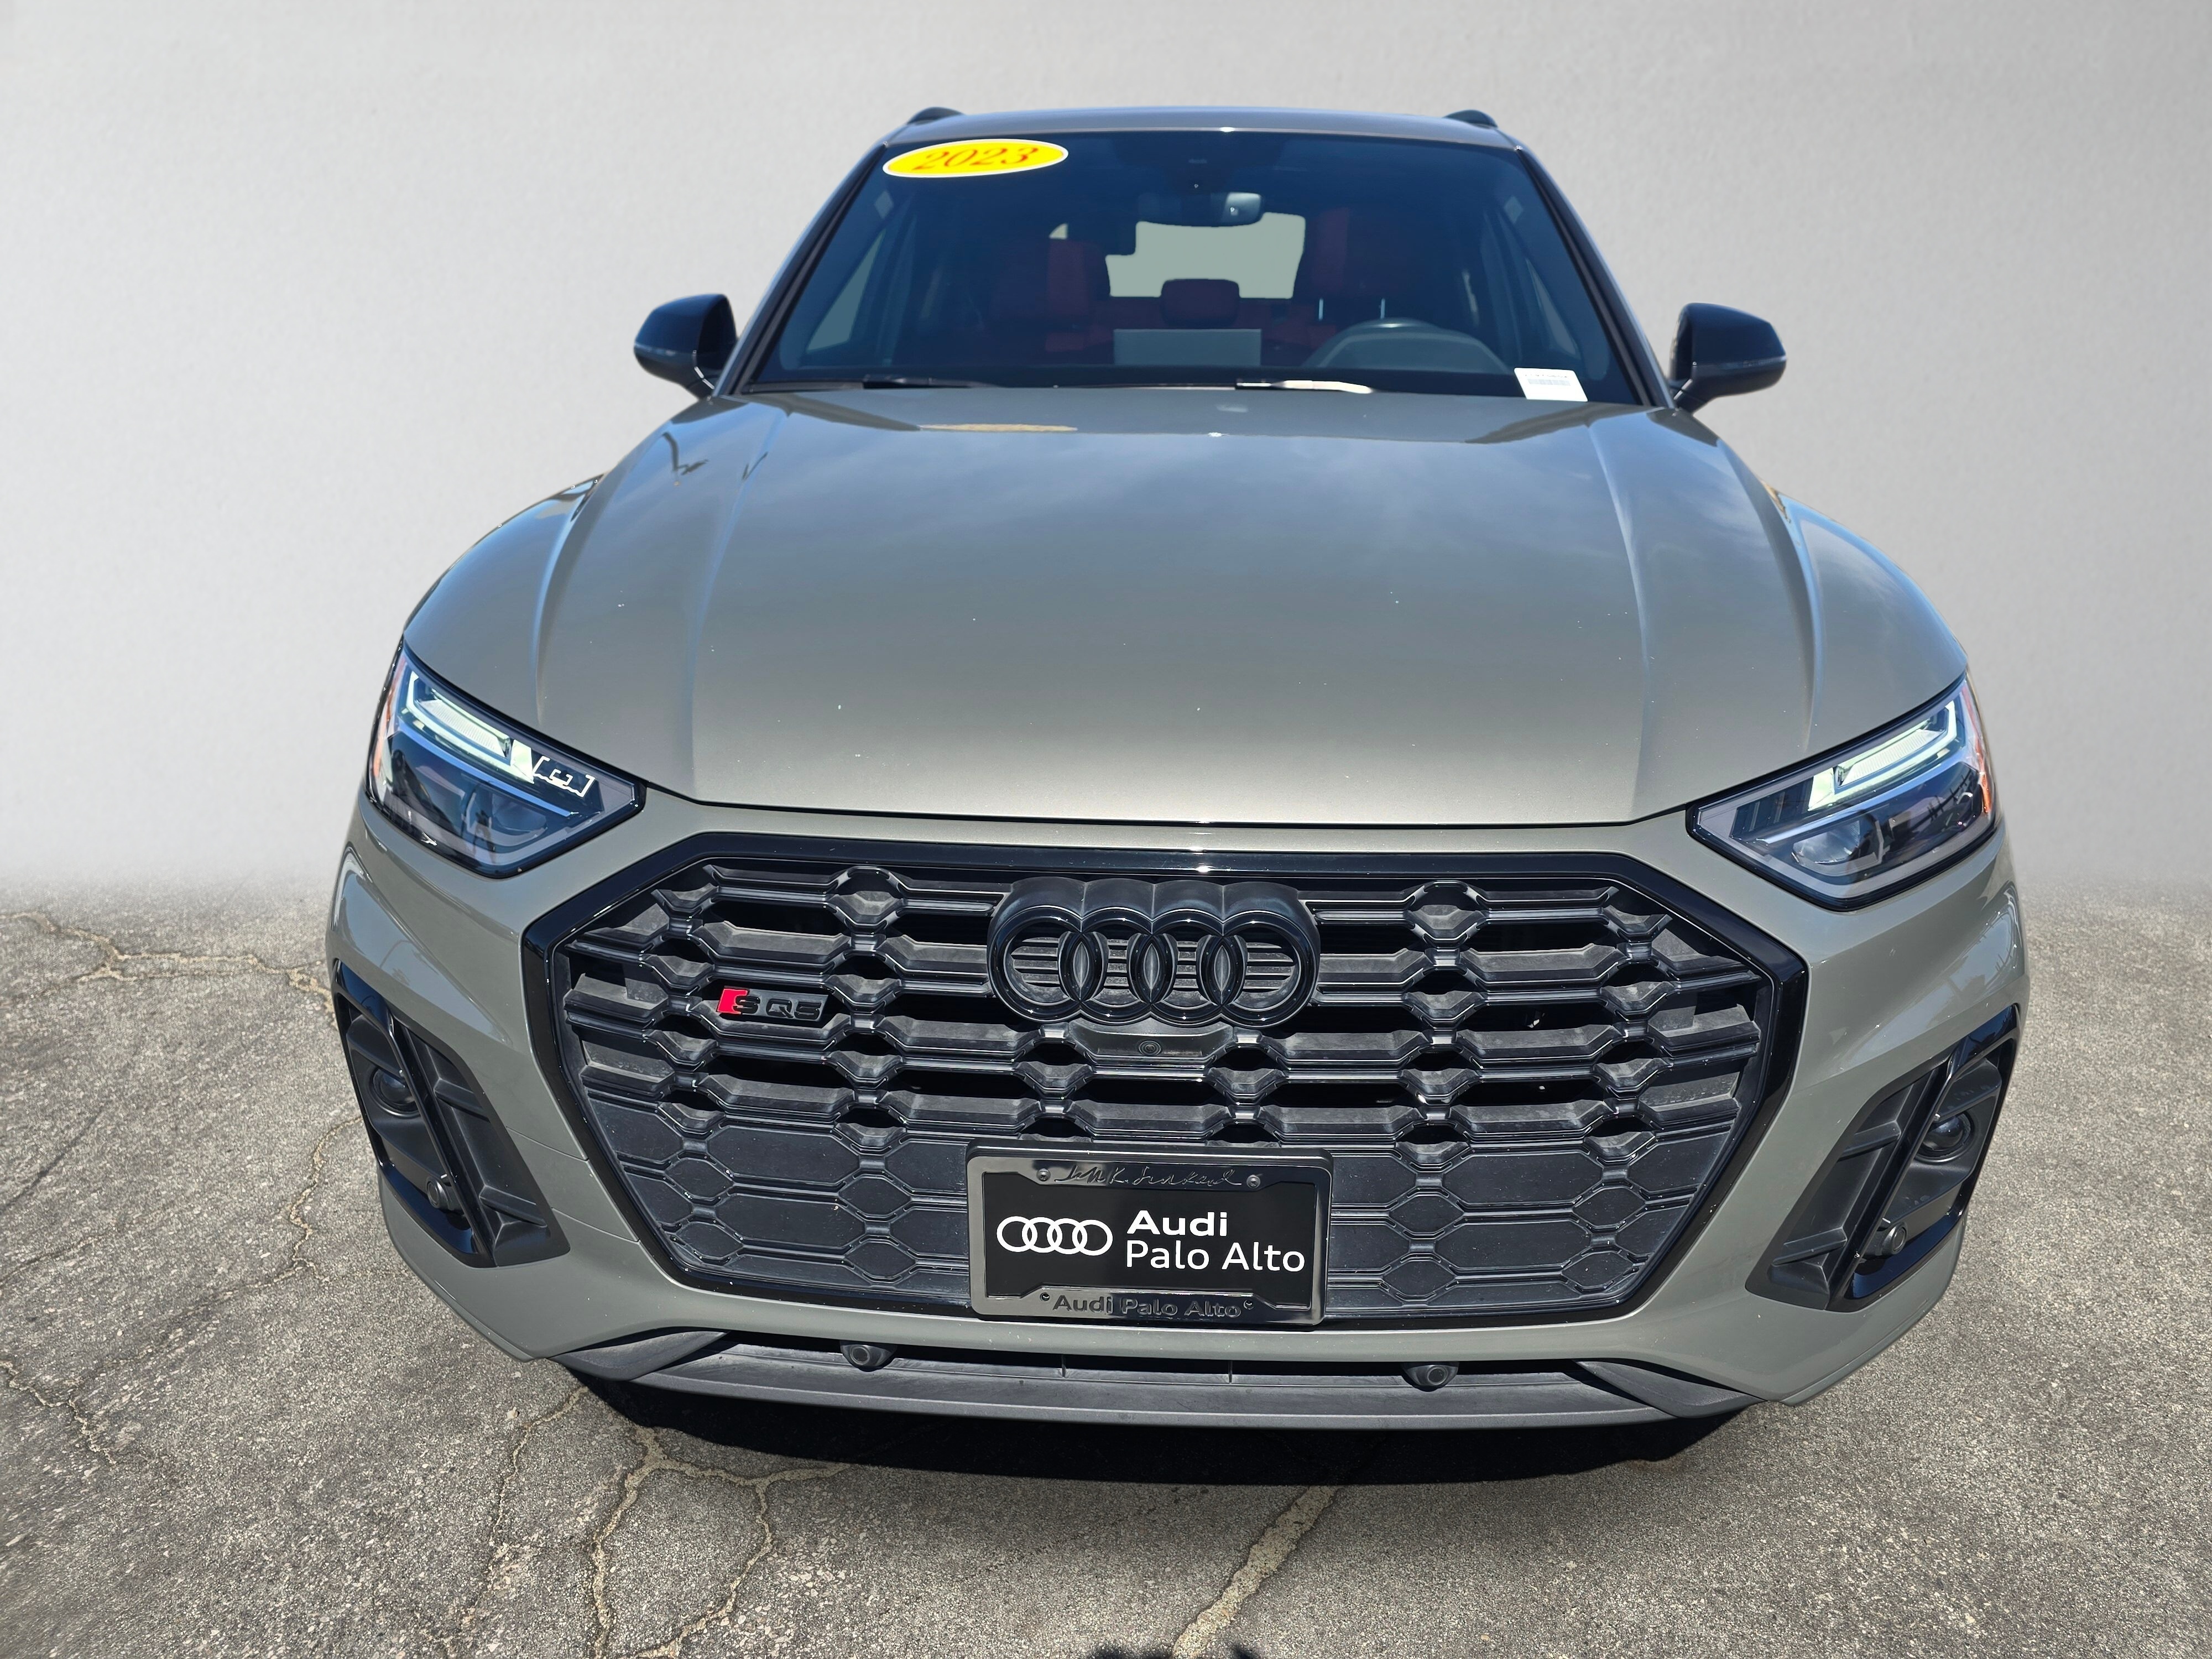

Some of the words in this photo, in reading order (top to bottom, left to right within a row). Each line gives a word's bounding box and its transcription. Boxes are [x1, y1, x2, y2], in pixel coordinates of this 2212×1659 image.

[911, 147, 1039, 170] 2023
[731, 994, 823, 1021] SQ5
[1126, 1210, 1228, 1237] Audi
[1126, 1239, 1210, 1270] Palo
[1221, 1241, 1306, 1272] Alto
[1052, 1295, 1113, 1315] Audi
[1120, 1296, 1178, 1316] Palo
[1183, 1300, 1241, 1318] Alto
